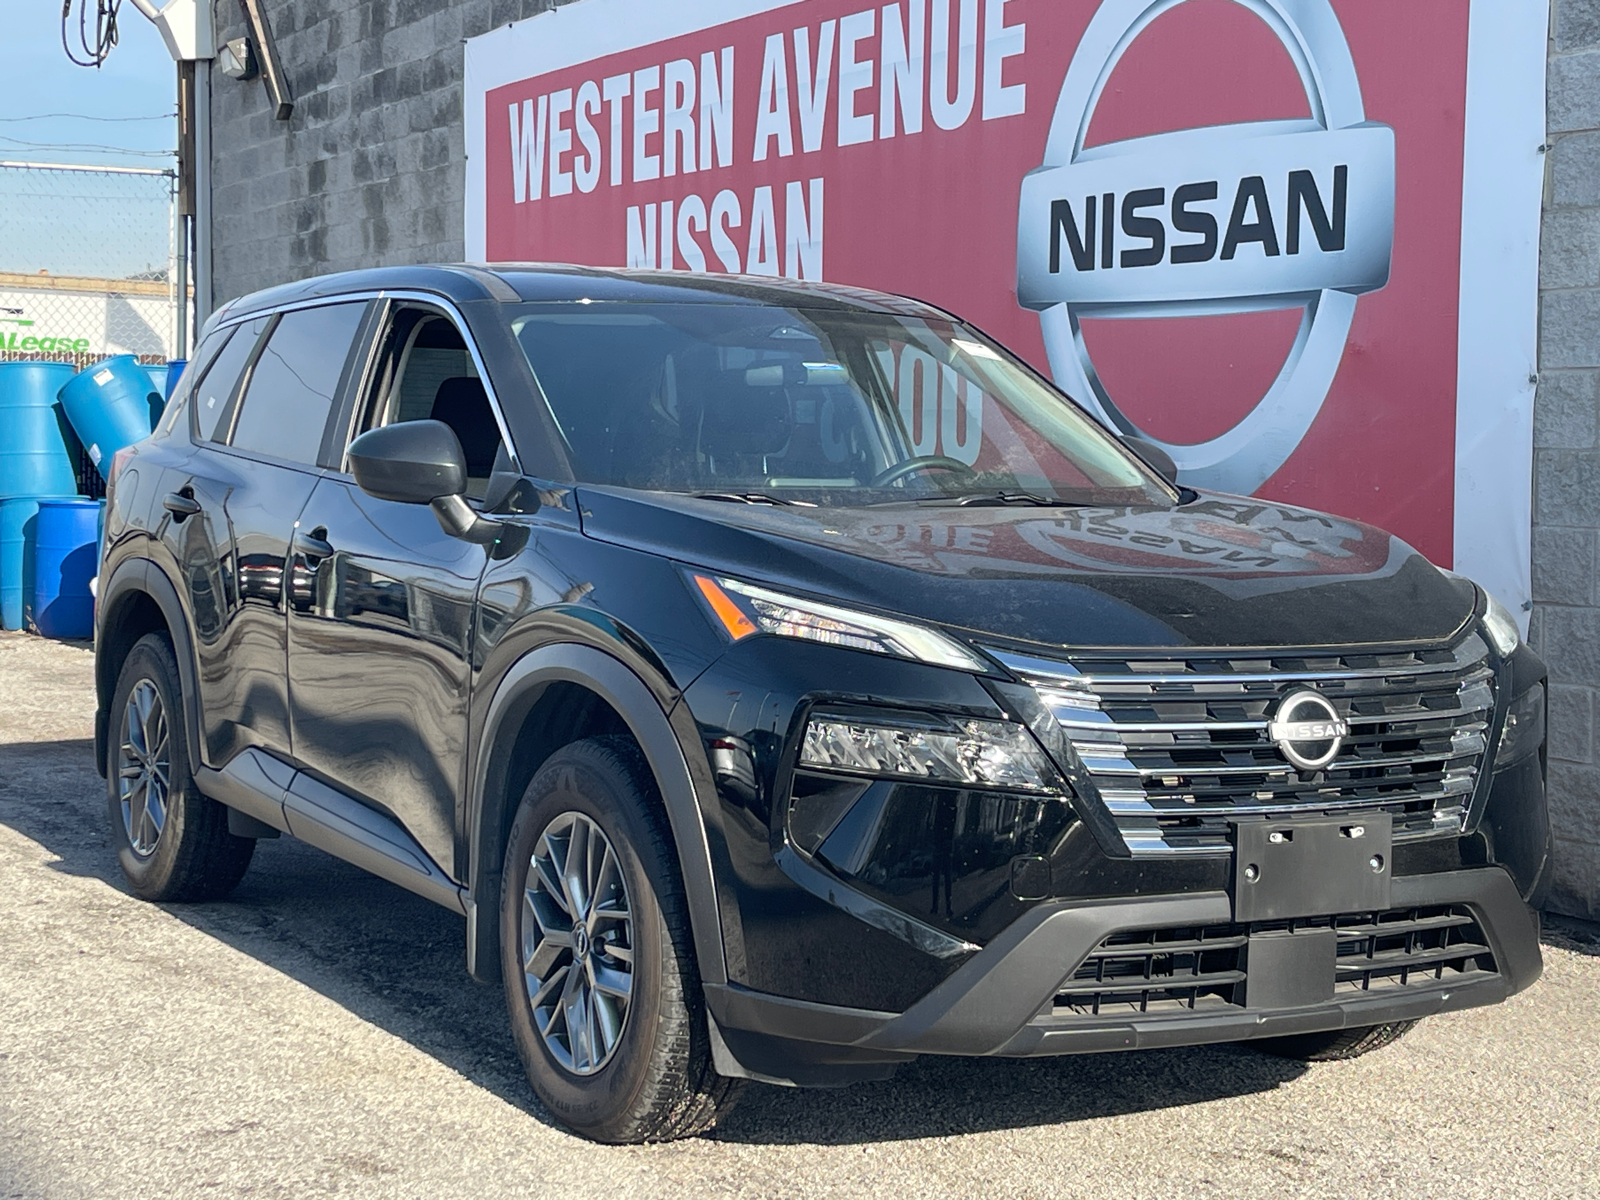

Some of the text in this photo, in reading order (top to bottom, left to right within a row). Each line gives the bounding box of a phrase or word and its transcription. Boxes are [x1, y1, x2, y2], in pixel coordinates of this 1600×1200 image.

[508, 0, 1026, 204] WESTERN AVENUE
[627, 178, 824, 282] NISSAN
[1049, 165, 1347, 273] NISSAN
[1276, 723, 1346, 738] NISSAN
